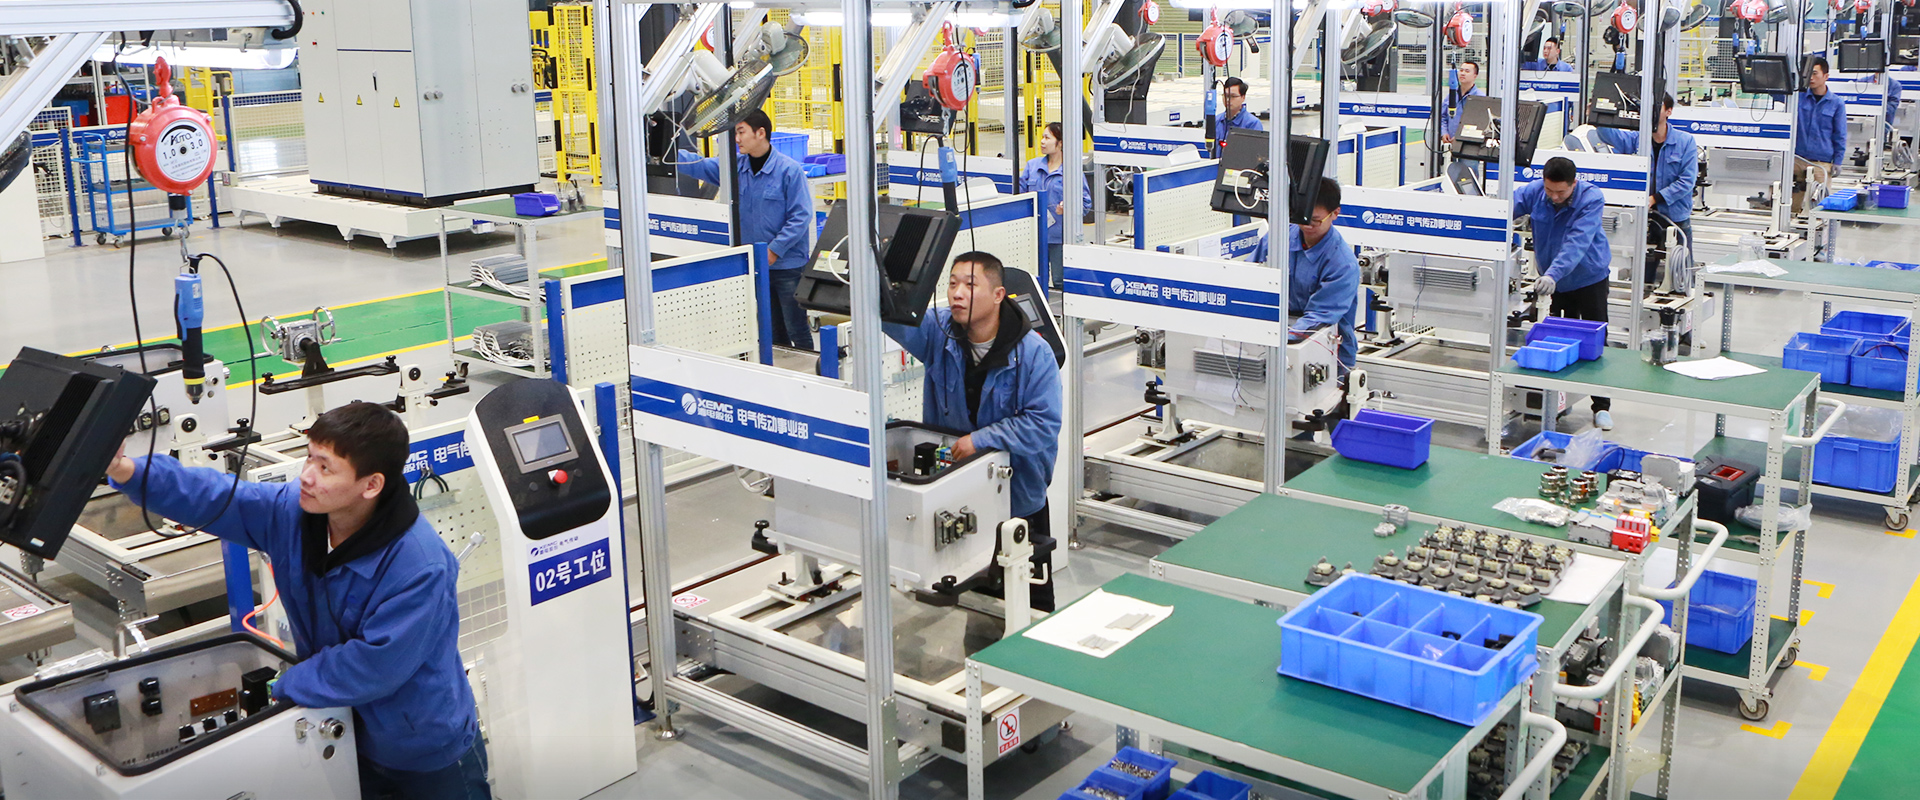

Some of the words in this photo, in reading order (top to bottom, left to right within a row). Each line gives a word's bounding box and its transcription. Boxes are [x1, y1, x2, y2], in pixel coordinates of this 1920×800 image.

[163, 148, 176, 160] 1.0
[190, 138, 204, 150] 3.0
[1375, 212, 1404, 221] XEMC
[1406, 216, 1462, 231] 电气传动事业部
[1125, 280, 1159, 292] XEMC
[1161, 286, 1227, 307] 电气传动事业部
[697, 397, 734, 415] XEMC
[737, 408, 809, 440] 电气传动事业部
[406, 449, 429, 464] MC
[535, 548, 607, 592] 02号工位
